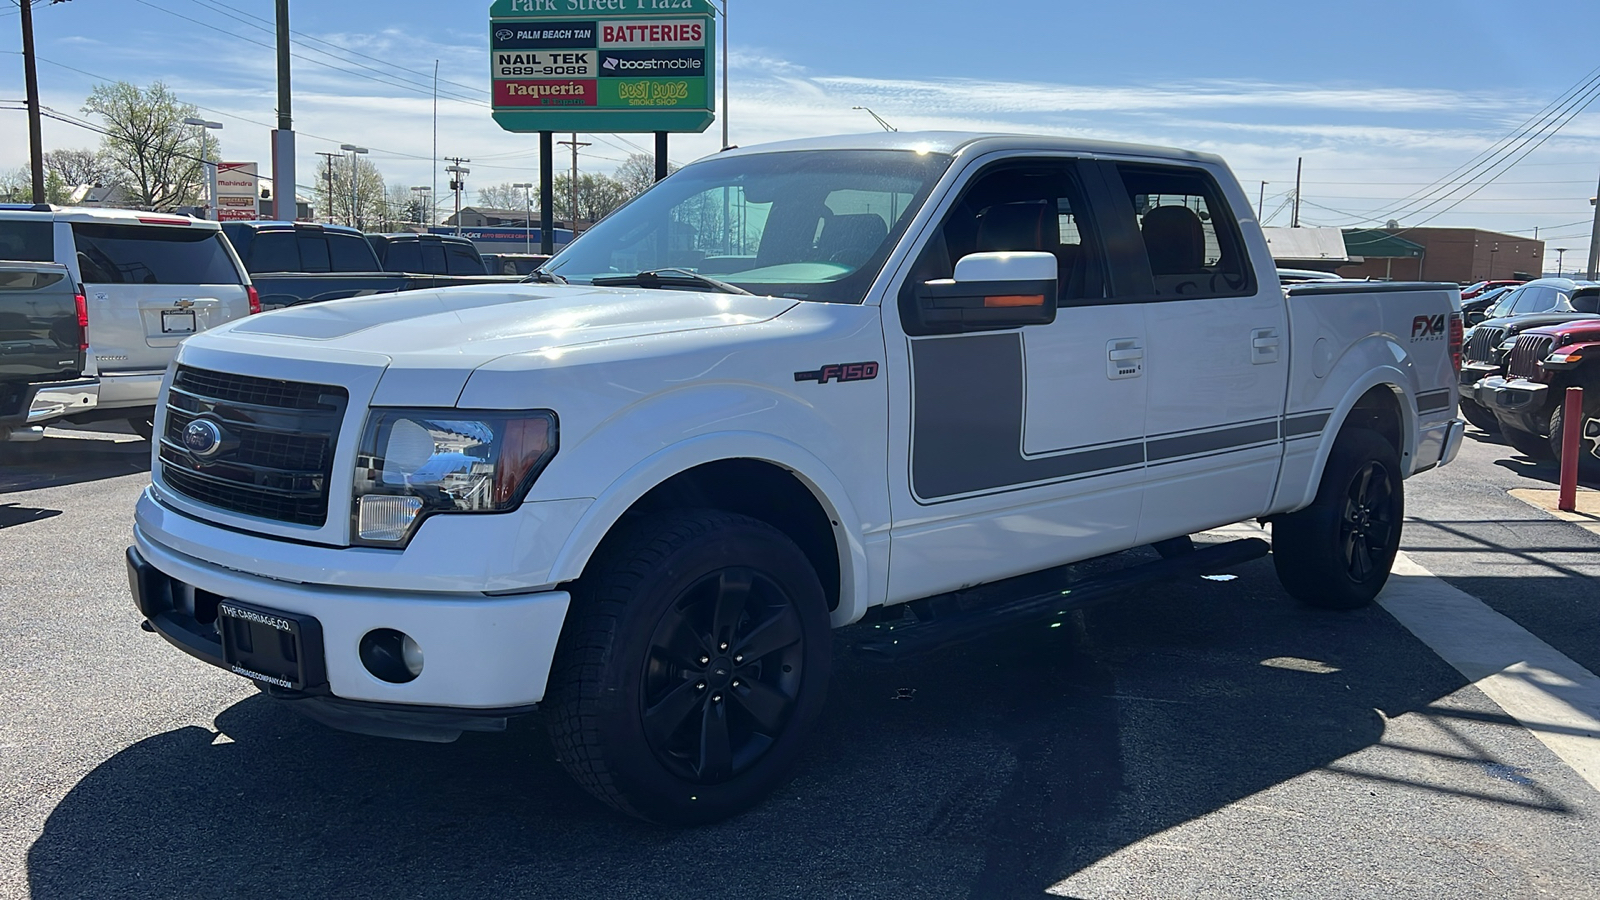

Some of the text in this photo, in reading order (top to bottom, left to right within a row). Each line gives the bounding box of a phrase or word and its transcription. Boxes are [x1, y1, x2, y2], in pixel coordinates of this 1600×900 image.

[516, 29, 592, 39] PALM BEACH TAN
[603, 24, 702, 43] BATTERIES
[499, 52, 589, 65] NAIL TEK
[501, 66, 588, 75] 689-9088
[628, 98, 678, 106] SMOKE SHOP
[1411, 314, 1445, 338] FX4
[822, 361, 879, 383] F-150
[221, 604, 237, 617] THE
[237, 609, 276, 627] CARRIAGE
[231, 665, 292, 689] CARRIAGECOMPANY.COM
